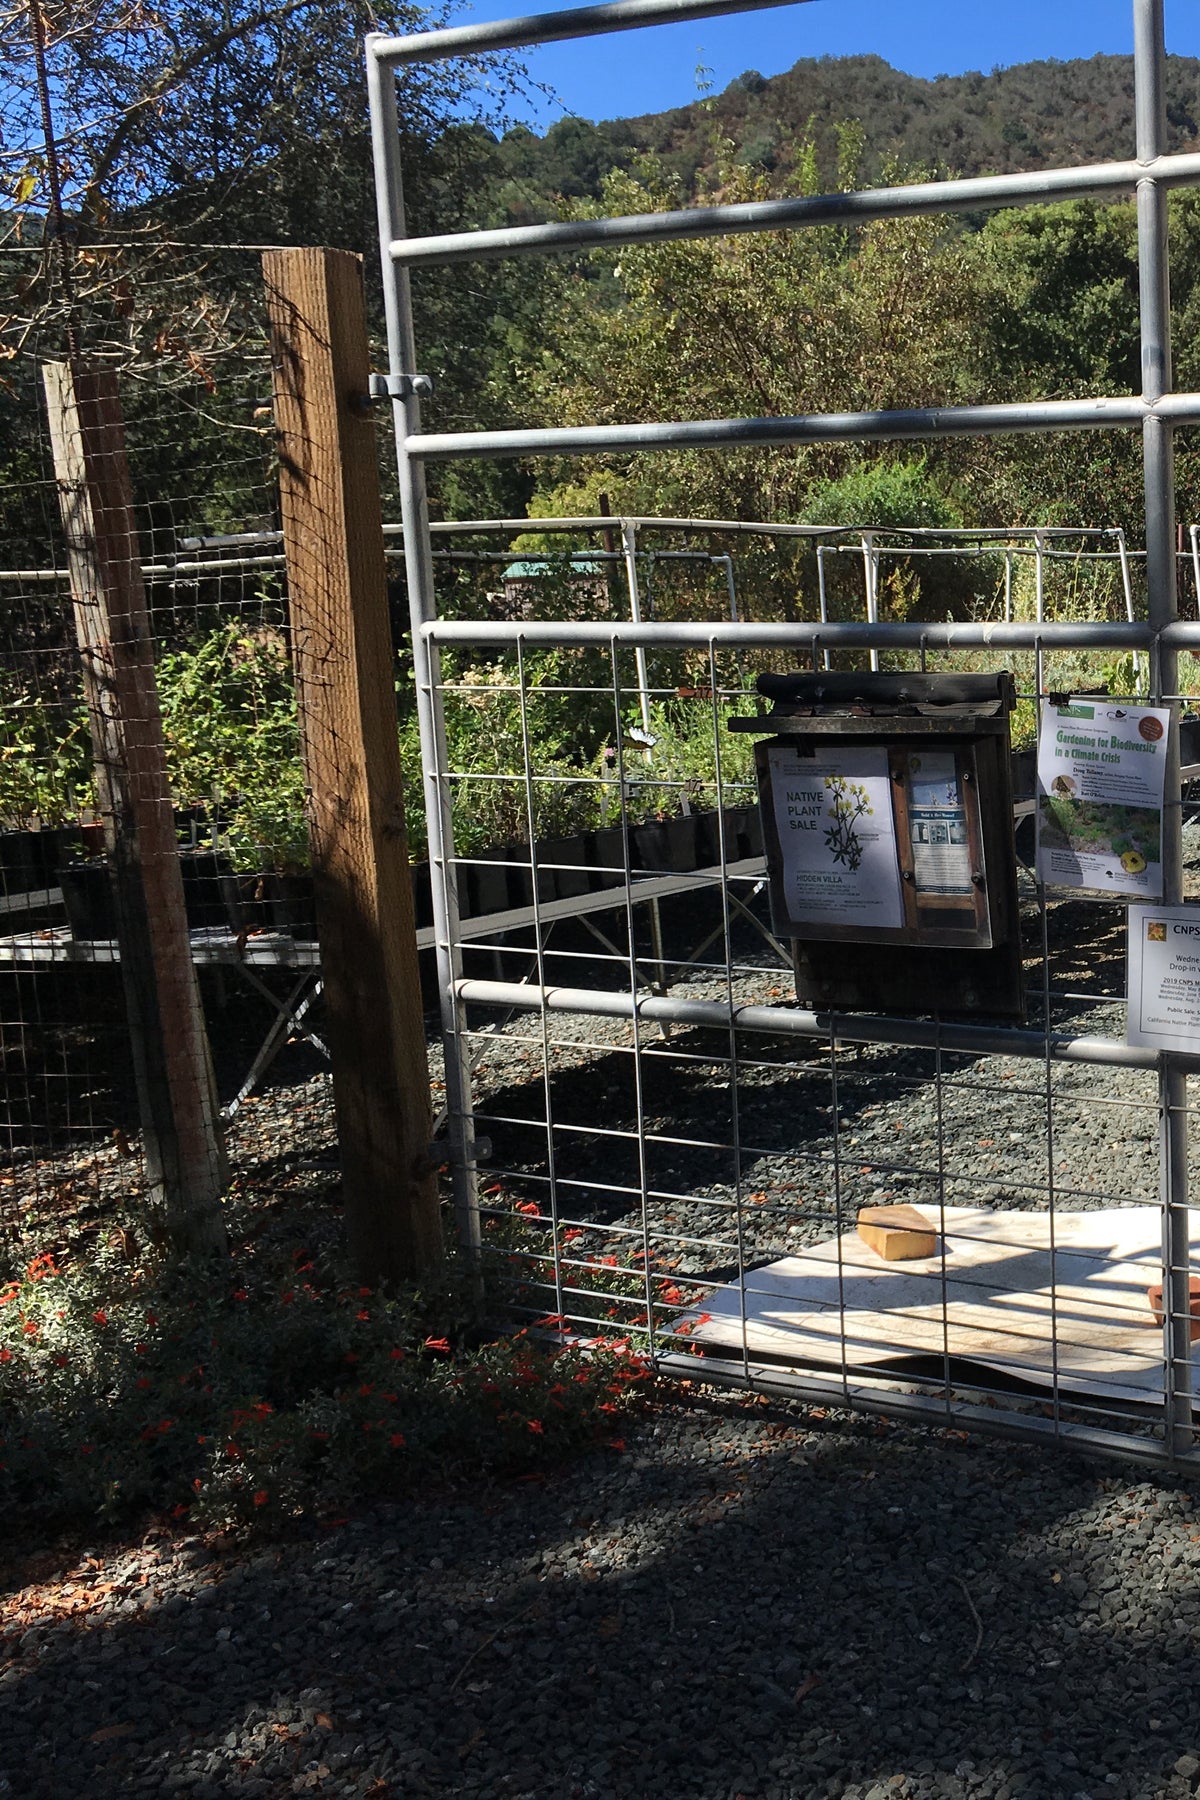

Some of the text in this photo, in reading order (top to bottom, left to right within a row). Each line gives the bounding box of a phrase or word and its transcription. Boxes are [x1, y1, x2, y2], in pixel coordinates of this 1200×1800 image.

[1056, 730, 1158, 755] Gardening for Biodiversity
[1055, 746, 1121, 764] in a Climate Crisis
[786, 791, 824, 802] NATIVE
[788, 806, 822, 817] PLANT
[790, 820, 818, 831] SALE
[822, 876, 843, 884] VILLA
[1173, 924, 1200, 936] CNPS
[1169, 963, 1196, 975] Drop-in
[1163, 977, 1178, 986] 2019
[1178, 979, 1194, 987] CNPS
[1167, 1007, 1183, 1015] Public
[1147, 1016, 1171, 1025] California
[1188, 1020, 1200, 1028] Plant
